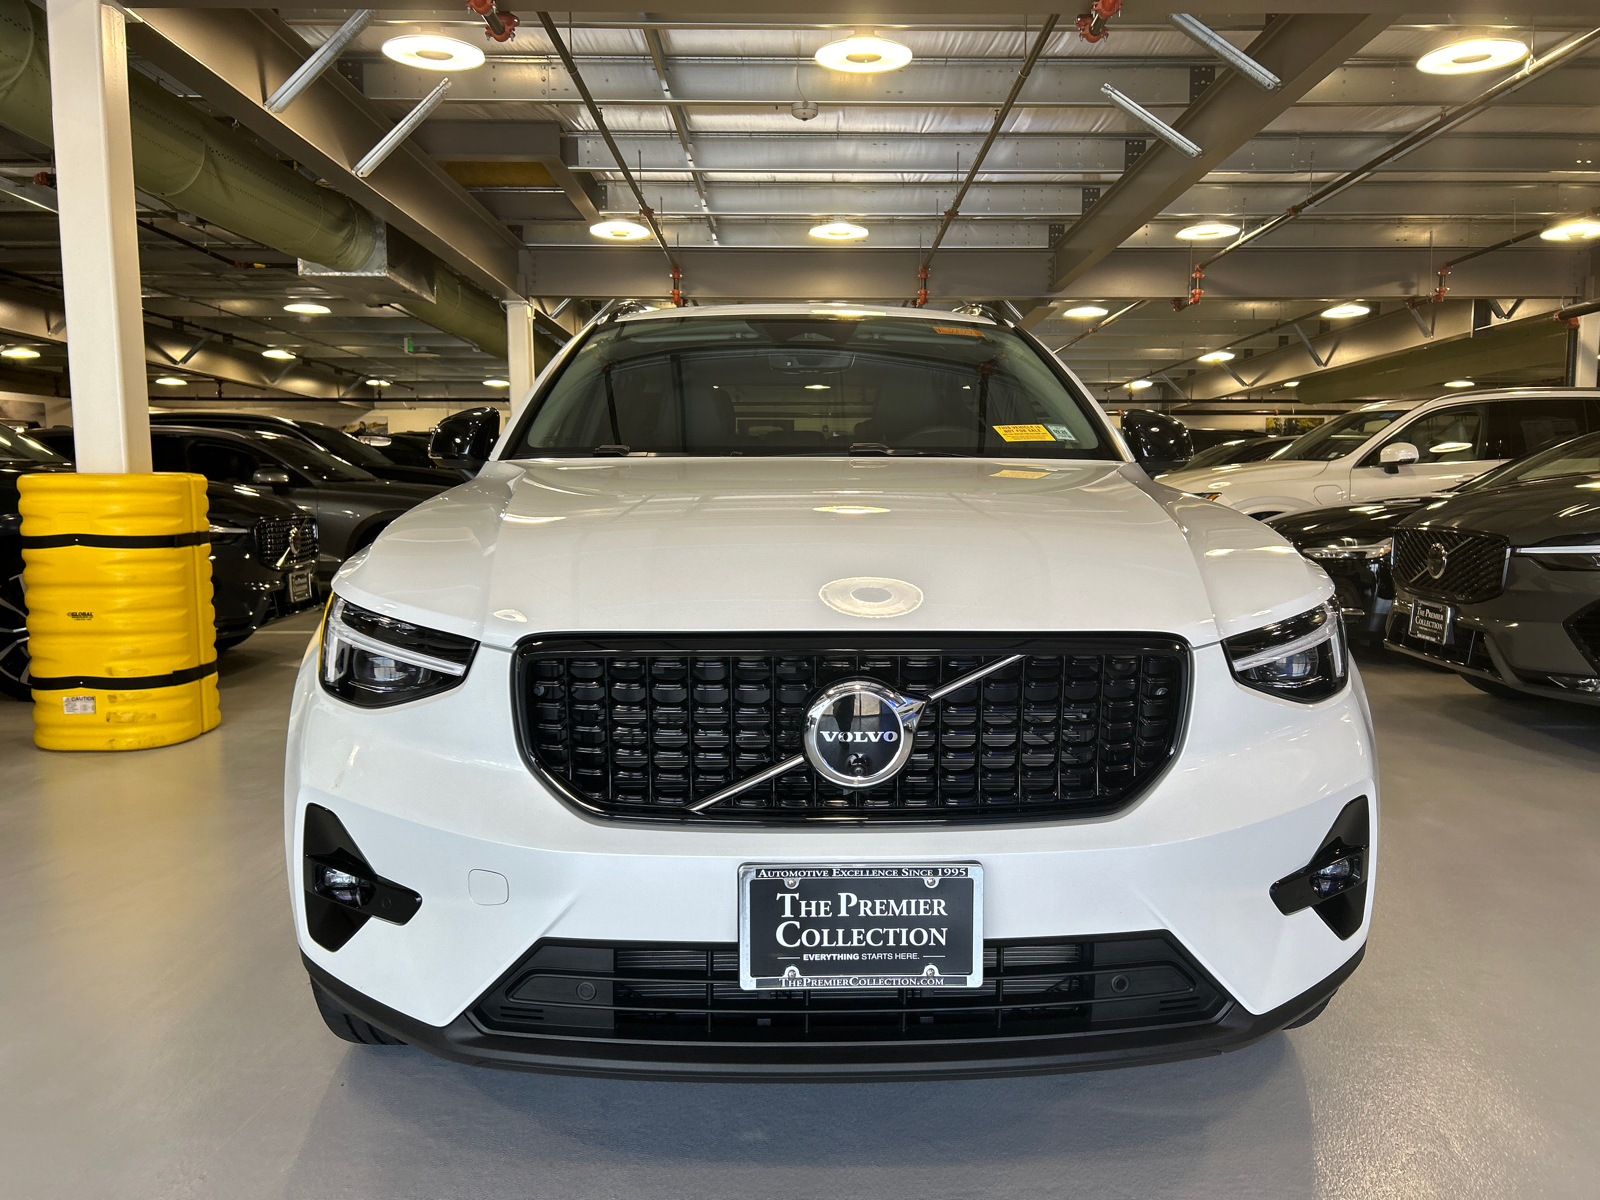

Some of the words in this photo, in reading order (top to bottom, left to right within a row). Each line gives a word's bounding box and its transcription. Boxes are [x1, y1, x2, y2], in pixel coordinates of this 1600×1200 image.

[820, 730, 899, 742] VOLVO
[937, 868, 966, 877] 1995
[803, 953, 860, 961] EVERYTHING
